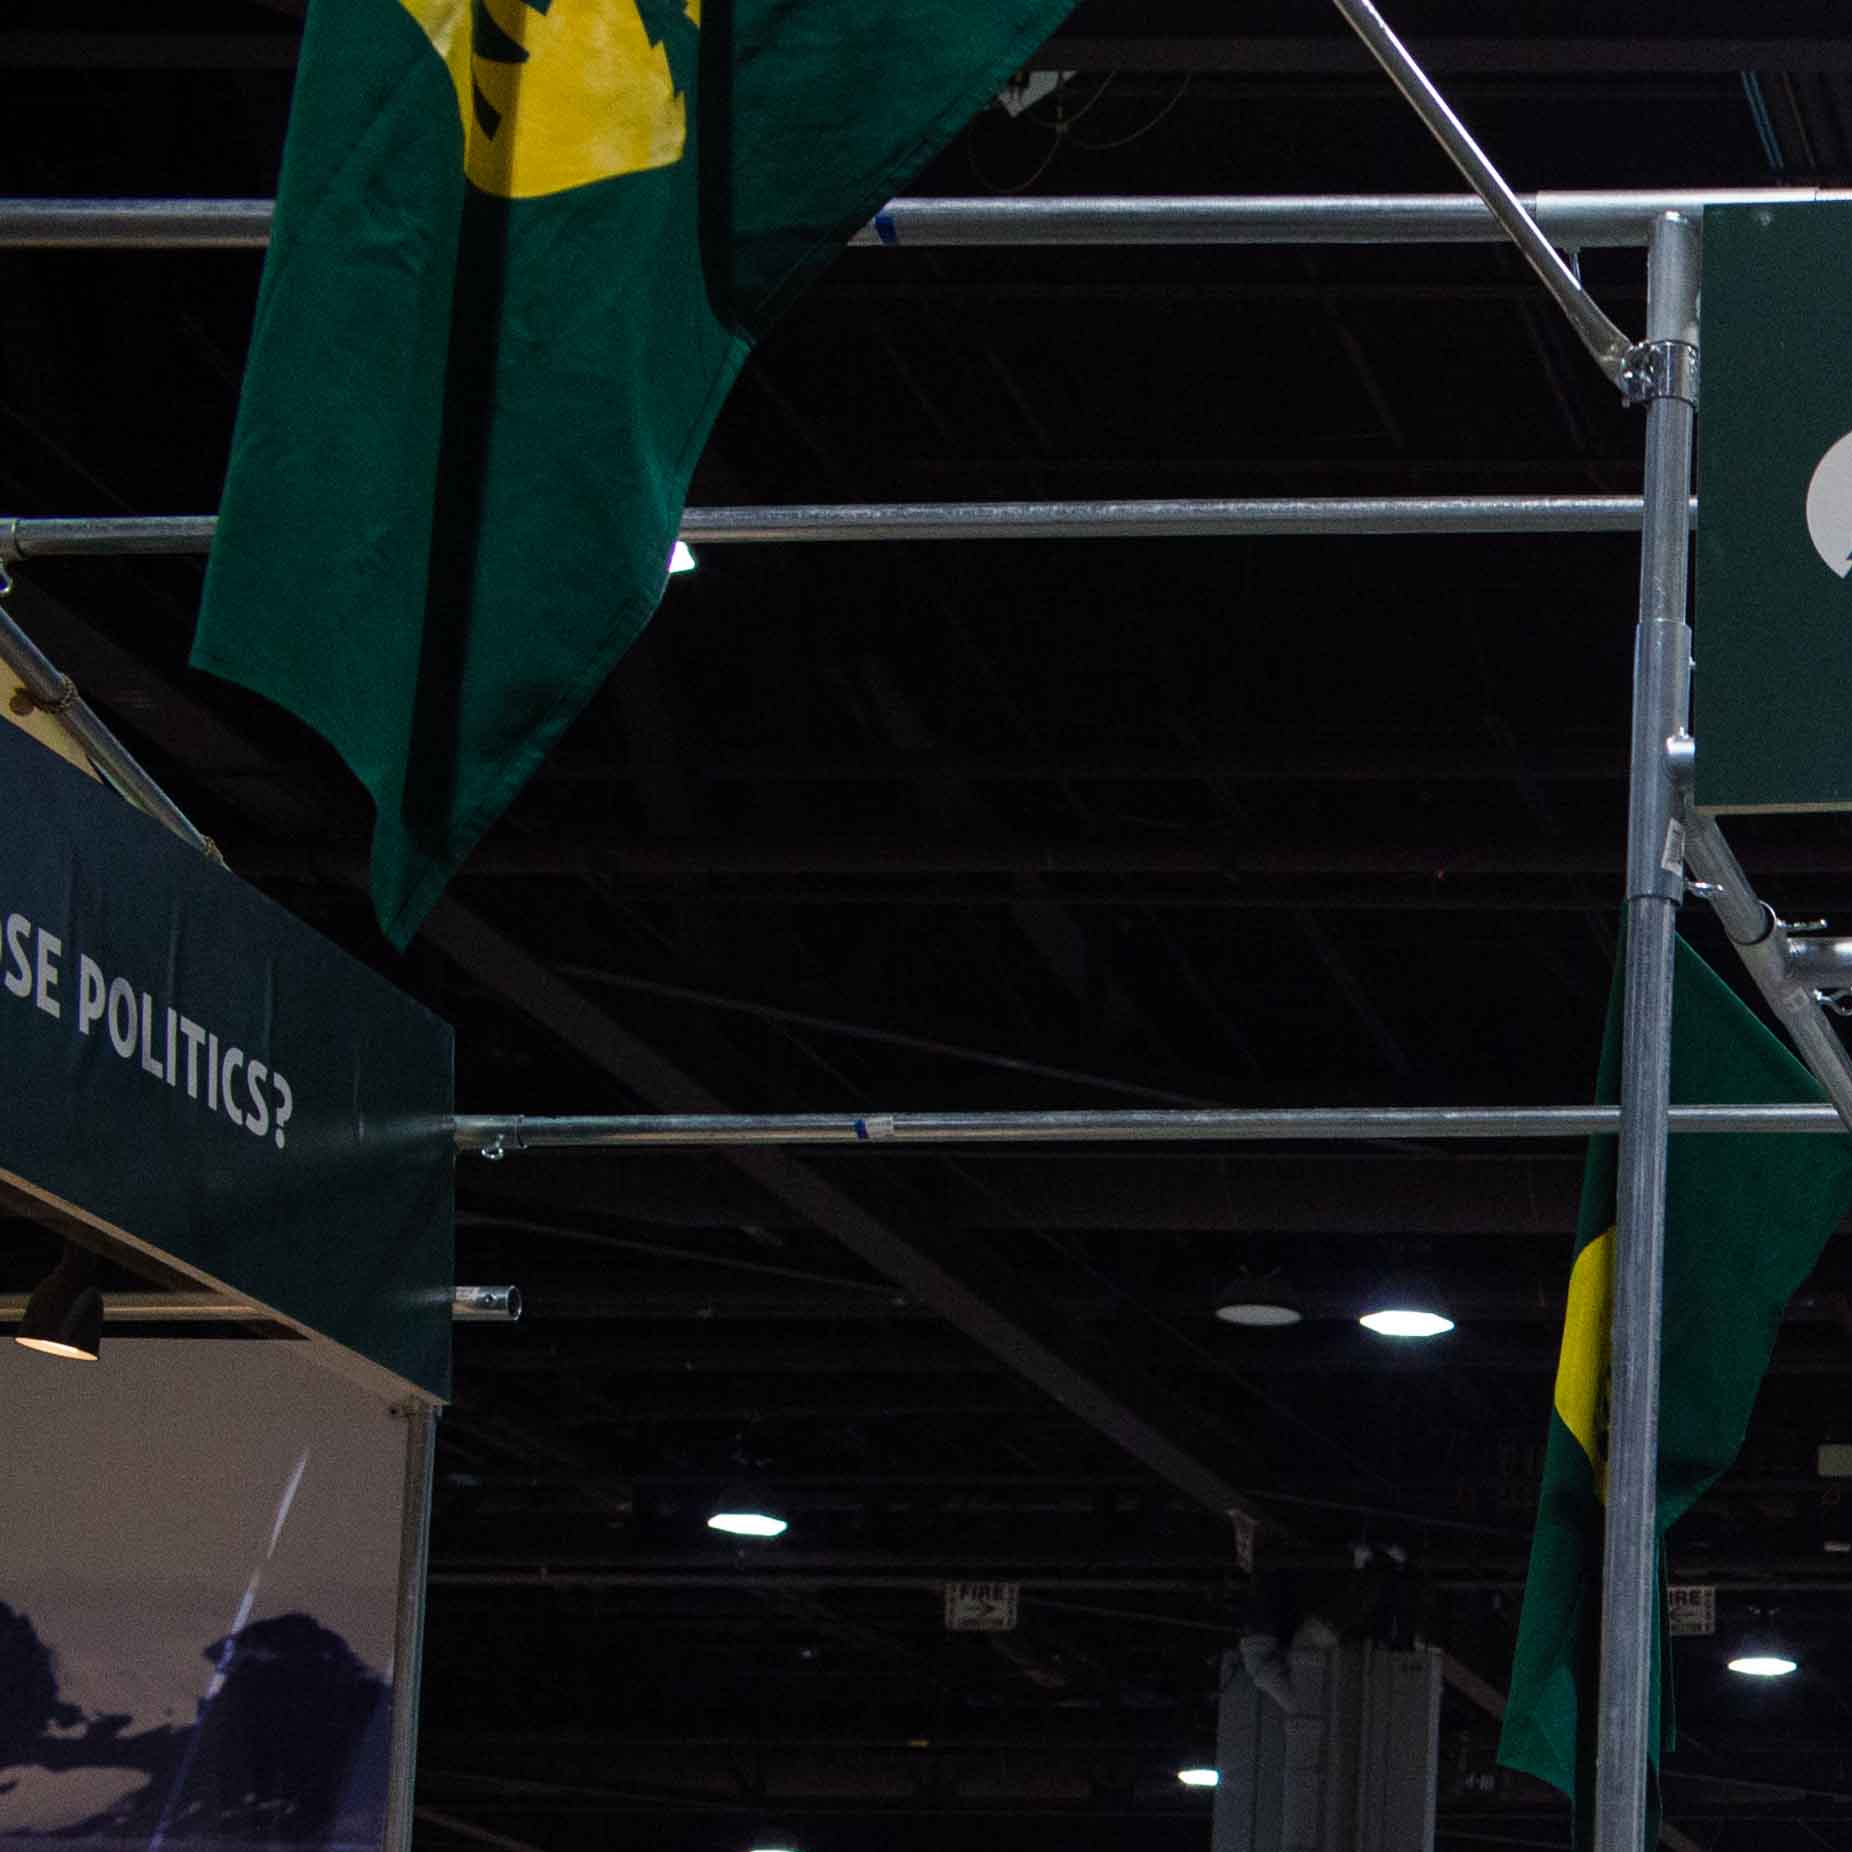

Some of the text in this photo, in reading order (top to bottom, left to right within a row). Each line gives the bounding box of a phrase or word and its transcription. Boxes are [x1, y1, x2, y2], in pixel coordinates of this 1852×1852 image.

[0, 913, 293, 1150] SE POLITICS?
[960, 1583, 1006, 1601] FIRE
[1669, 1589, 1701, 1607] IRE
